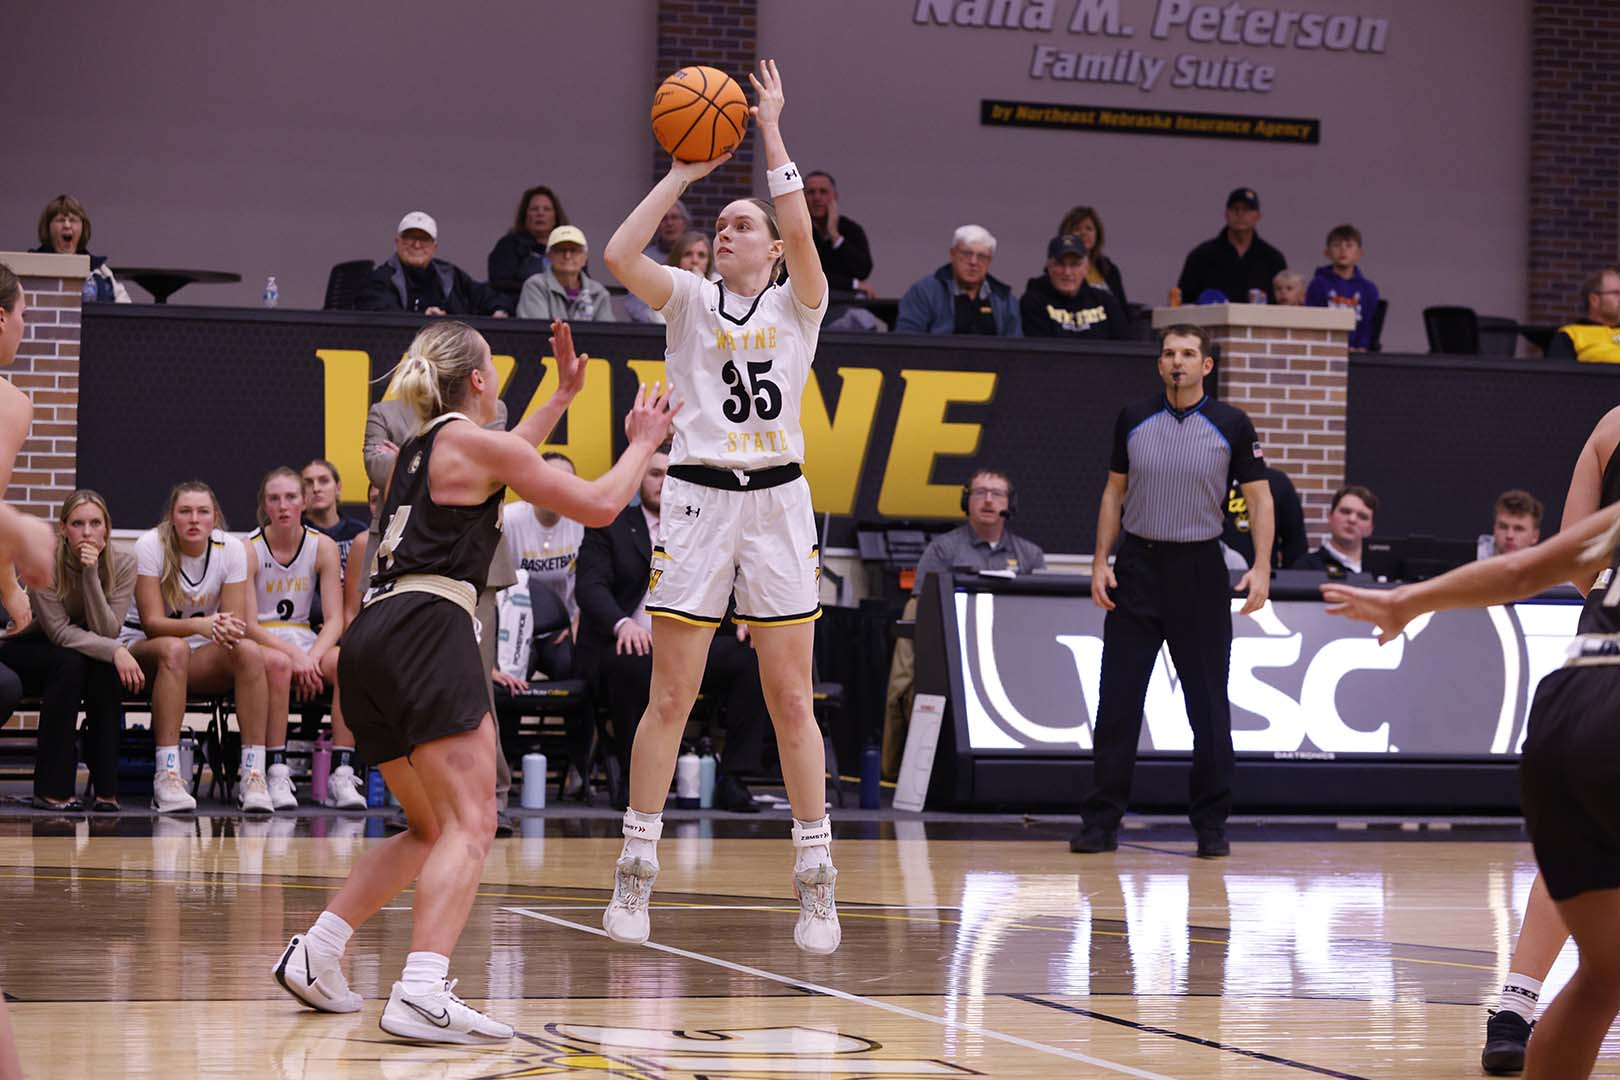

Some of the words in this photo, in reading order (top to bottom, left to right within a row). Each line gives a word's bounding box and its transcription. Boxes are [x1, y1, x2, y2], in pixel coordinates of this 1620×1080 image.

[1069, 0, 1135, 36] M.
[1152, 0, 1389, 53] Peterson
[1030, 46, 1165, 91] Family
[1171, 54, 1276, 92] Suite
[991, 104, 1013, 122] by
[1015, 105, 1096, 125] Northeast
[1099, 110, 1173, 130] Nebraska
[1175, 115, 1252, 133] Insurance
[1254, 119, 1313, 138] Agency
[714, 326, 777, 352] WAYNE
[721, 359, 783, 424] 35
[727, 429, 789, 453] STATE
[265, 576, 309, 593] WAYNE
